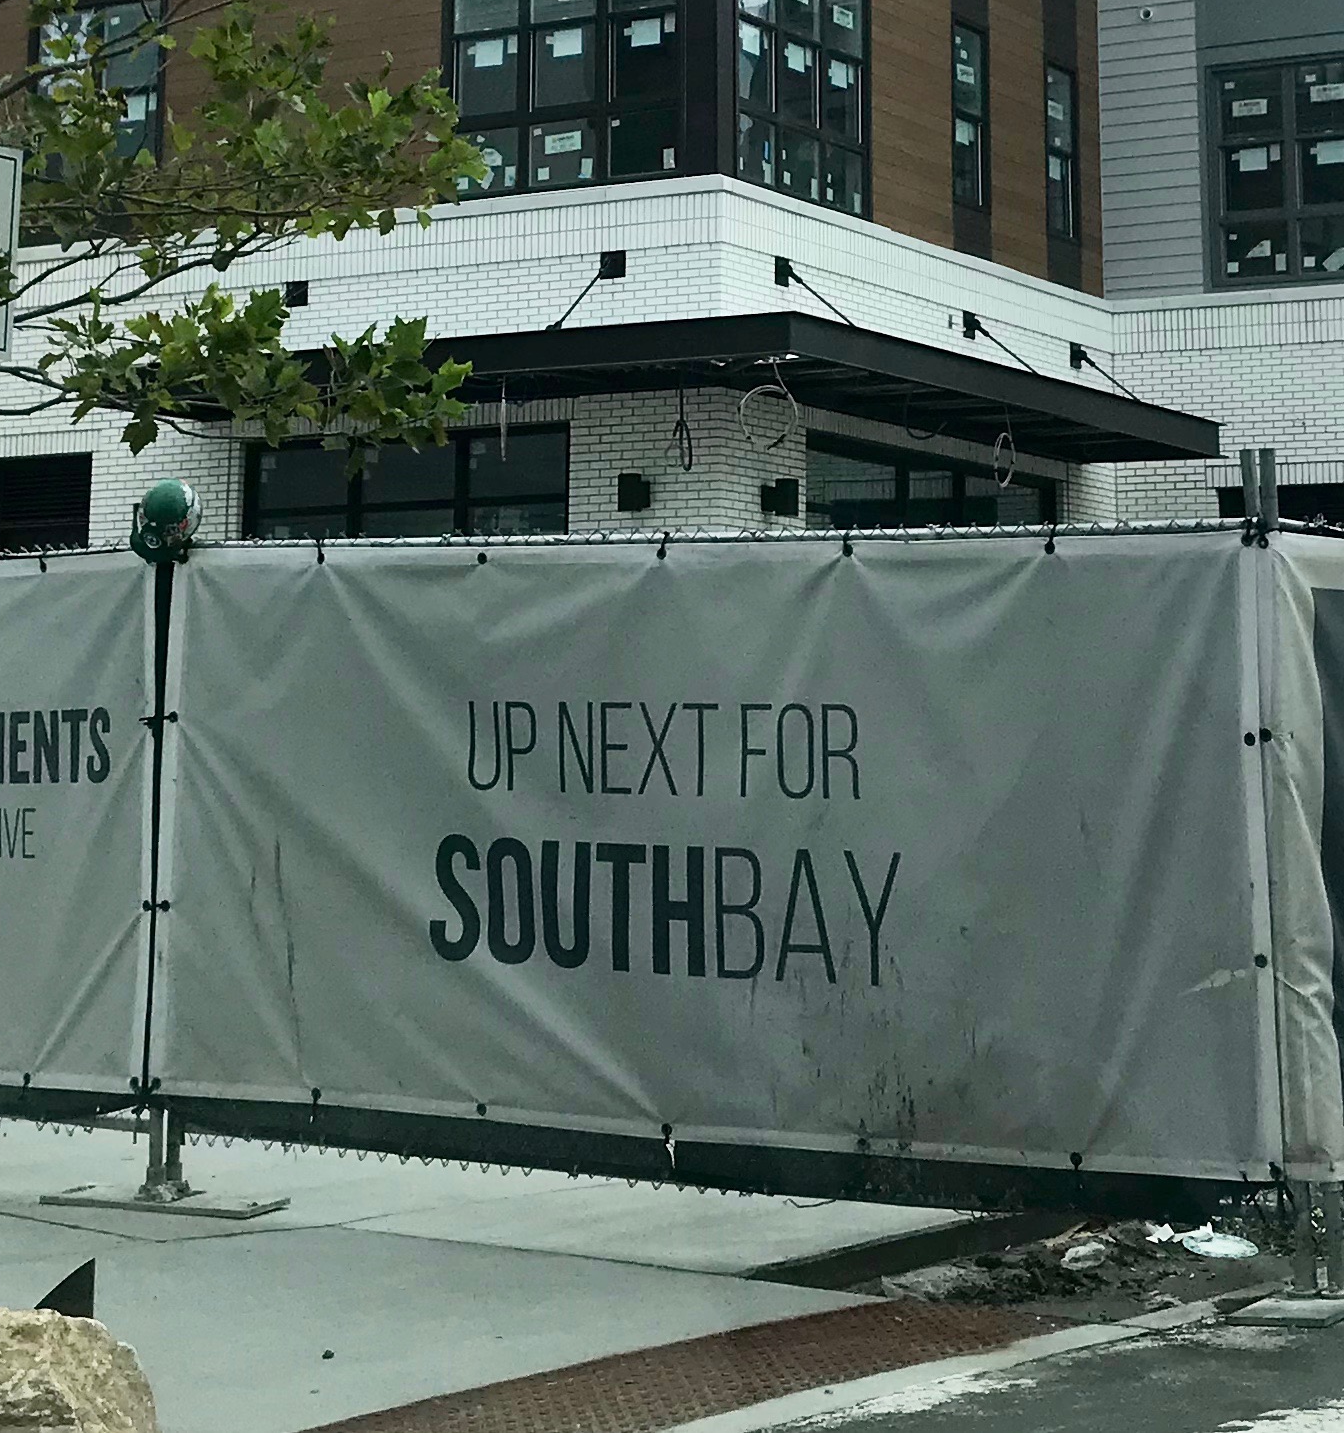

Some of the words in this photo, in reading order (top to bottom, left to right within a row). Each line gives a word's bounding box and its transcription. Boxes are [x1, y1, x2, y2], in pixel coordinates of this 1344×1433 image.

[467, 700, 537, 791] UP
[558, 701, 719, 796] NEXT
[739, 702, 860, 799] FOR
